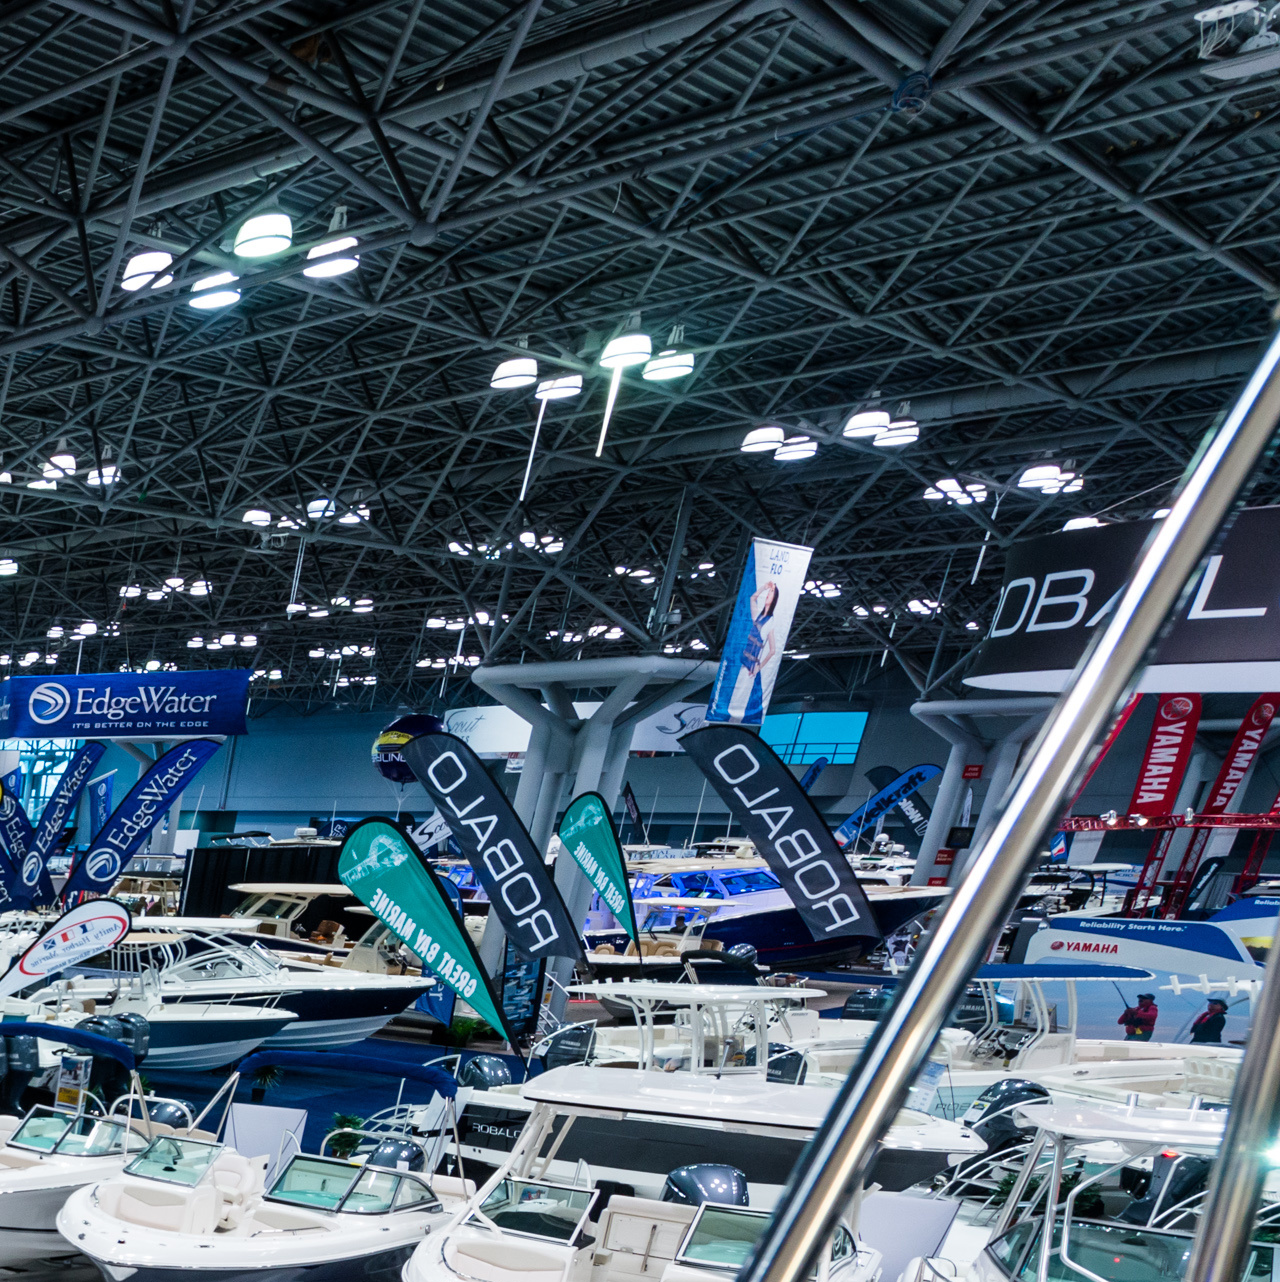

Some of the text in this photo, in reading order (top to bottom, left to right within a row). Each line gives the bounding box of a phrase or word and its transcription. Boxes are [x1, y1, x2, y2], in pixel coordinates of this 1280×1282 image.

[985, 555, 1268, 638] OBL
[74, 686, 217, 720] EdgeWater
[107, 748, 198, 851] EdgeWater
[1136, 721, 1188, 804] YAMAHA
[1212, 728, 1264, 807] YAMAHA
[37, 751, 93, 854] EdgeWater
[1066, 941, 1119, 954] YAMAHA
[1079, 920, 1125, 931] Reliability
[1128, 922, 1156, 931] Starts
[472, 1122, 522, 1140] ROBALO
